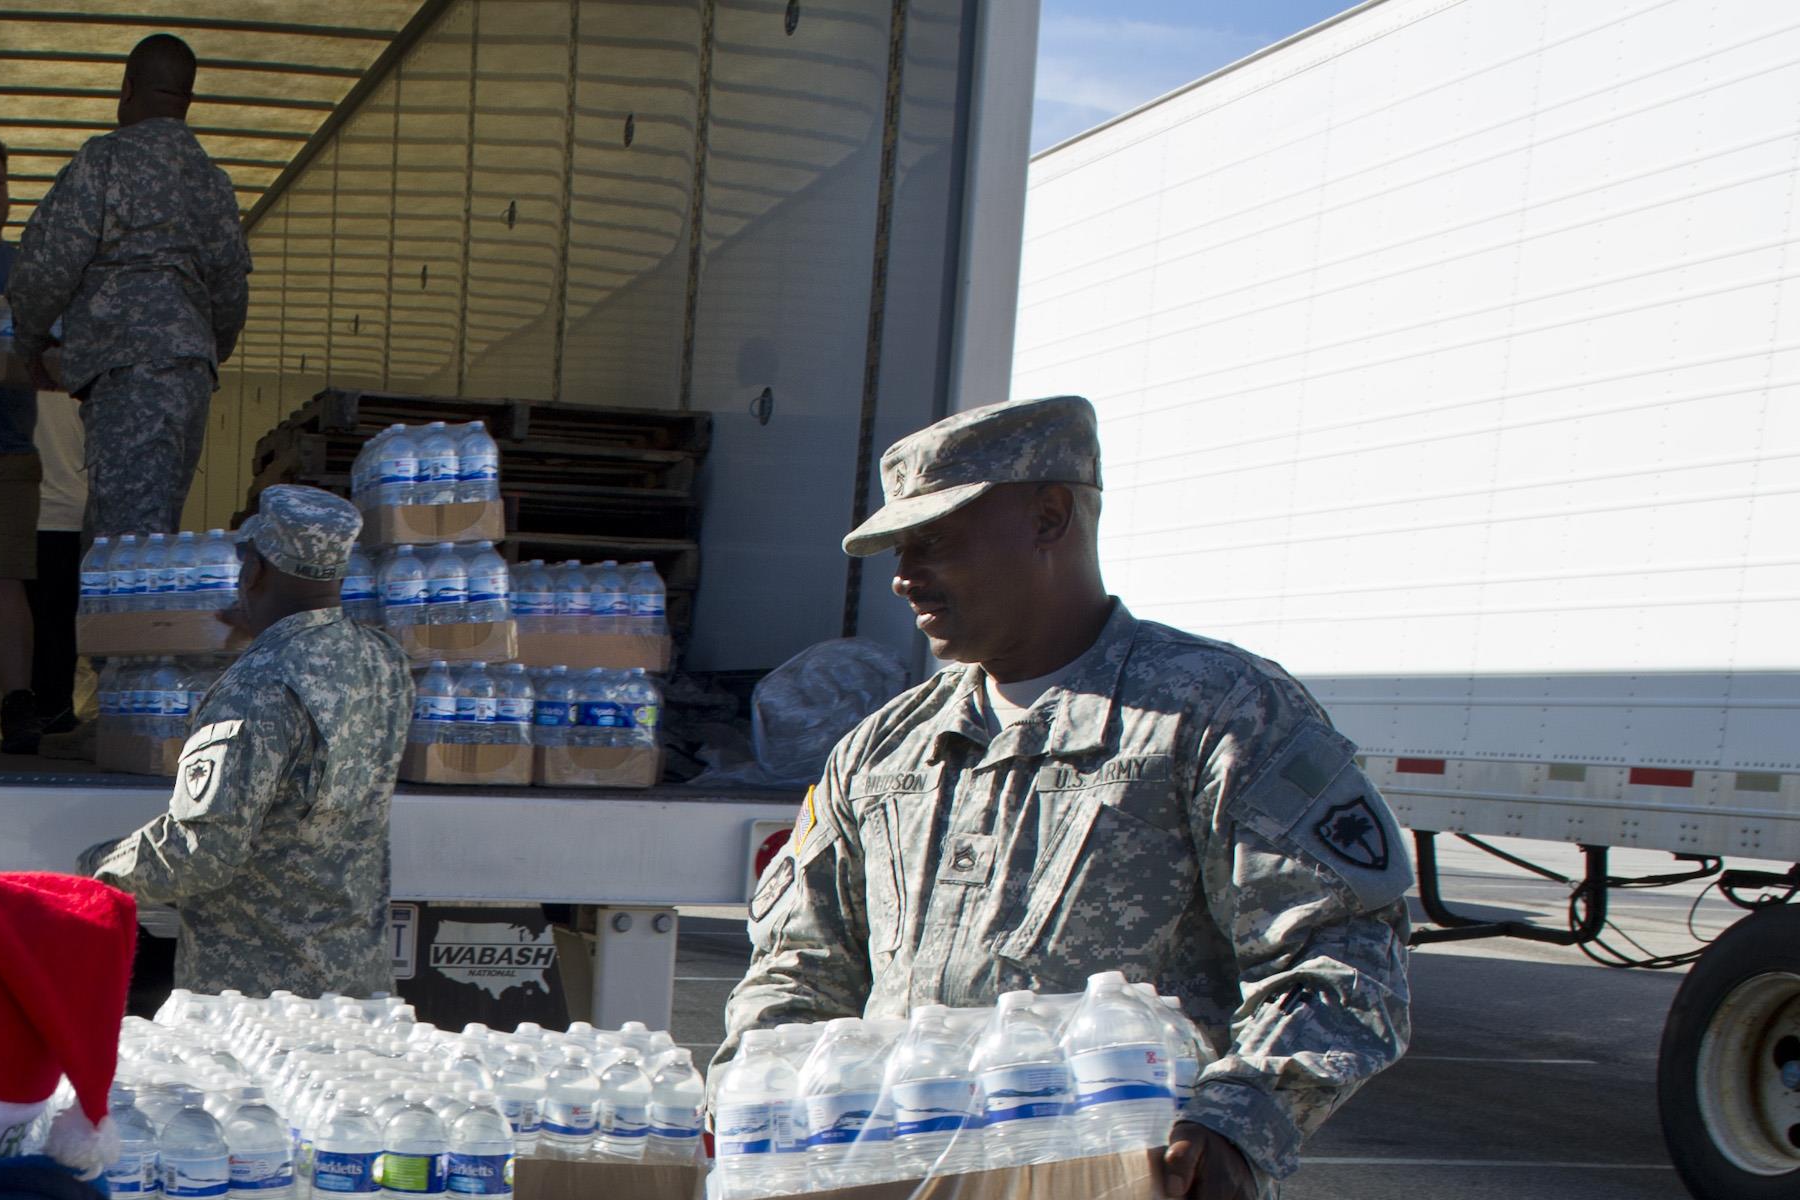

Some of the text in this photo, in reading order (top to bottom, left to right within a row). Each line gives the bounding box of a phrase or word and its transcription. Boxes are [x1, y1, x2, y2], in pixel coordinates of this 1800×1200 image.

[864, 772, 929, 793] HUDSON
[1054, 757, 1150, 790] U.S. ARMY
[433, 945, 555, 967] WABASH
[466, 969, 518, 978] NATIONAL
